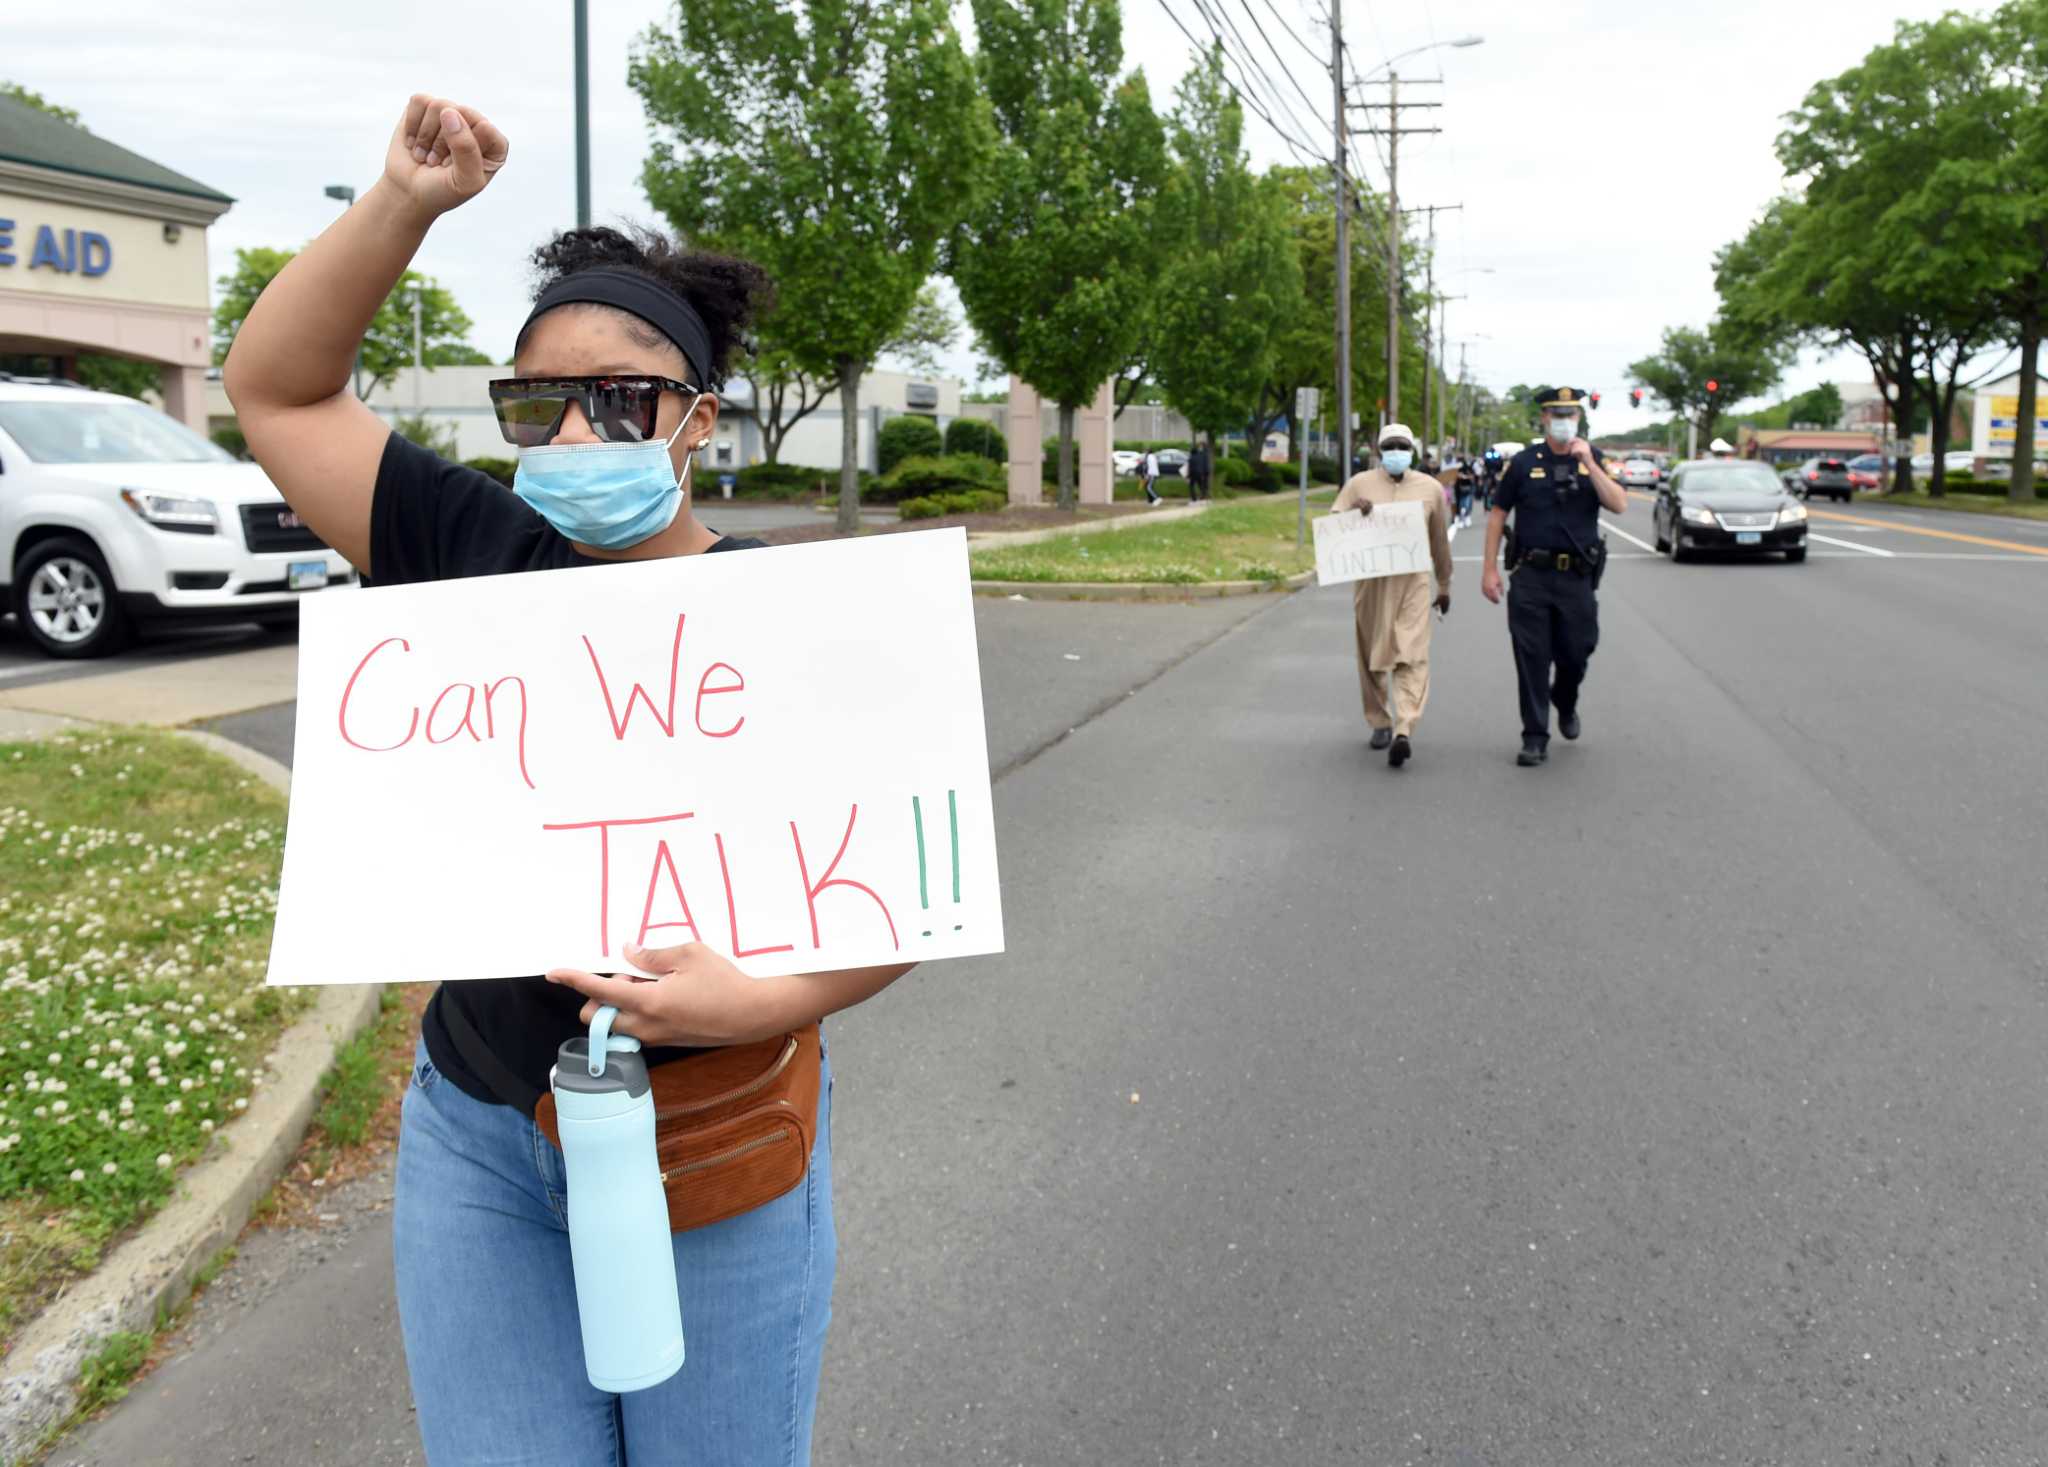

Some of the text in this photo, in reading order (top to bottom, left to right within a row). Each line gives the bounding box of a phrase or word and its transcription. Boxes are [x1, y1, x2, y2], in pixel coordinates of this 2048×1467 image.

[29, 224, 111, 277] AID
[338, 613, 745, 789] Can We
[542, 789, 963, 958] TALK!!
